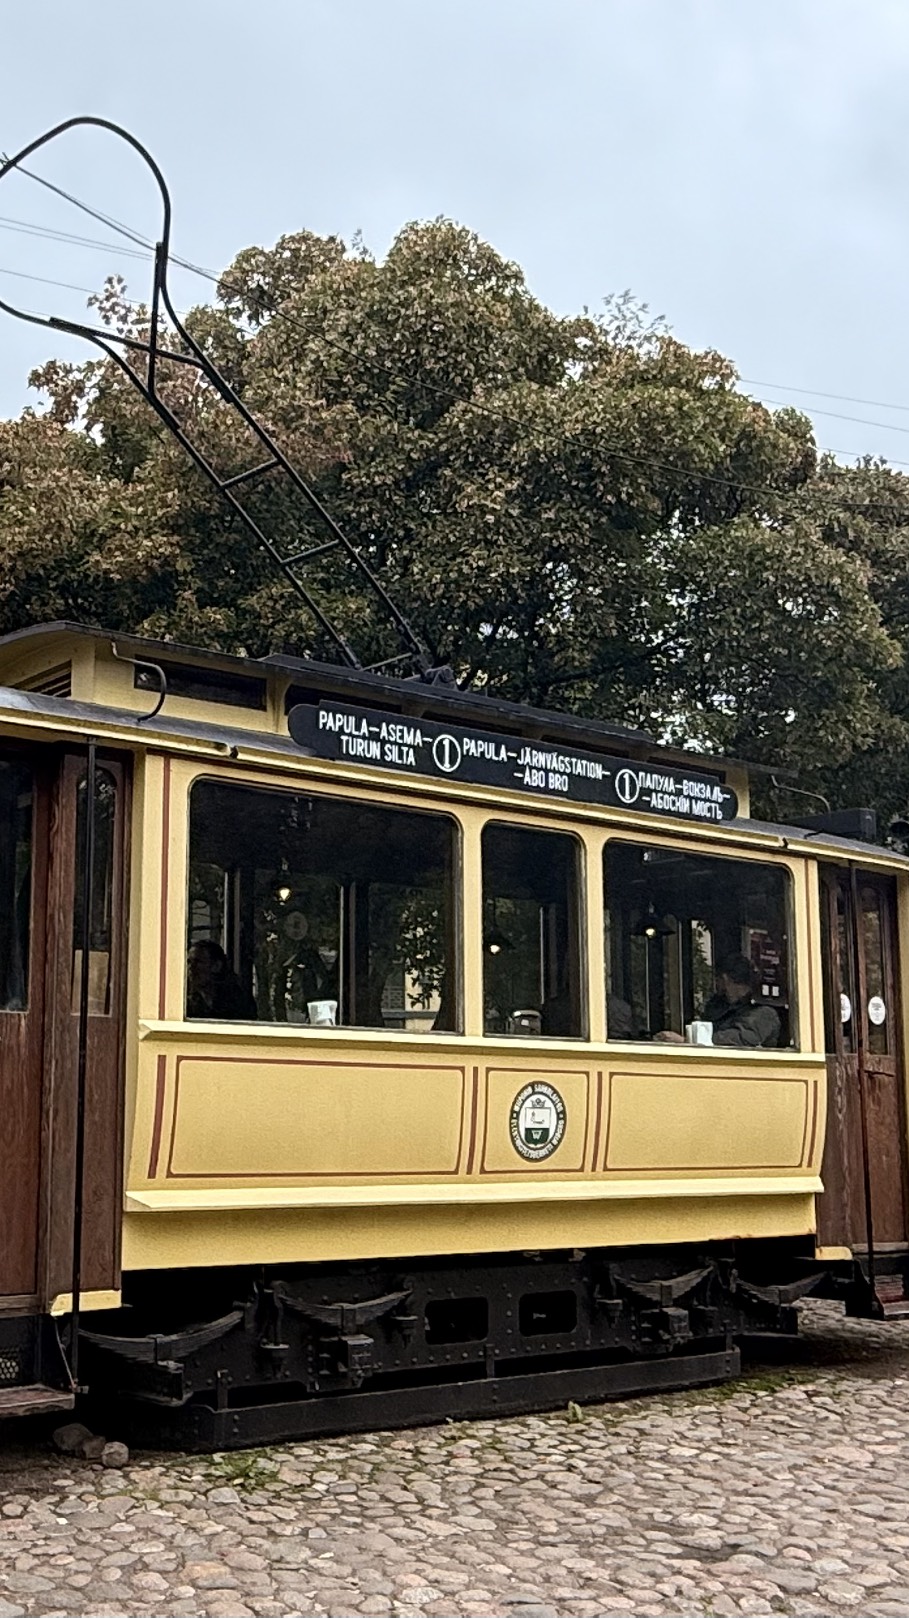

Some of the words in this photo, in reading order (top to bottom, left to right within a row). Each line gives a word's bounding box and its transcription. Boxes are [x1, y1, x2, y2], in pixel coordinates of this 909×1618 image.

[340, 736, 381, 760] TURUN
[384, 744, 416, 766] SILTA
[442, 737, 452, 769] 1
[548, 772, 569, 792] BRO
[622, 772, 632, 800] 1
